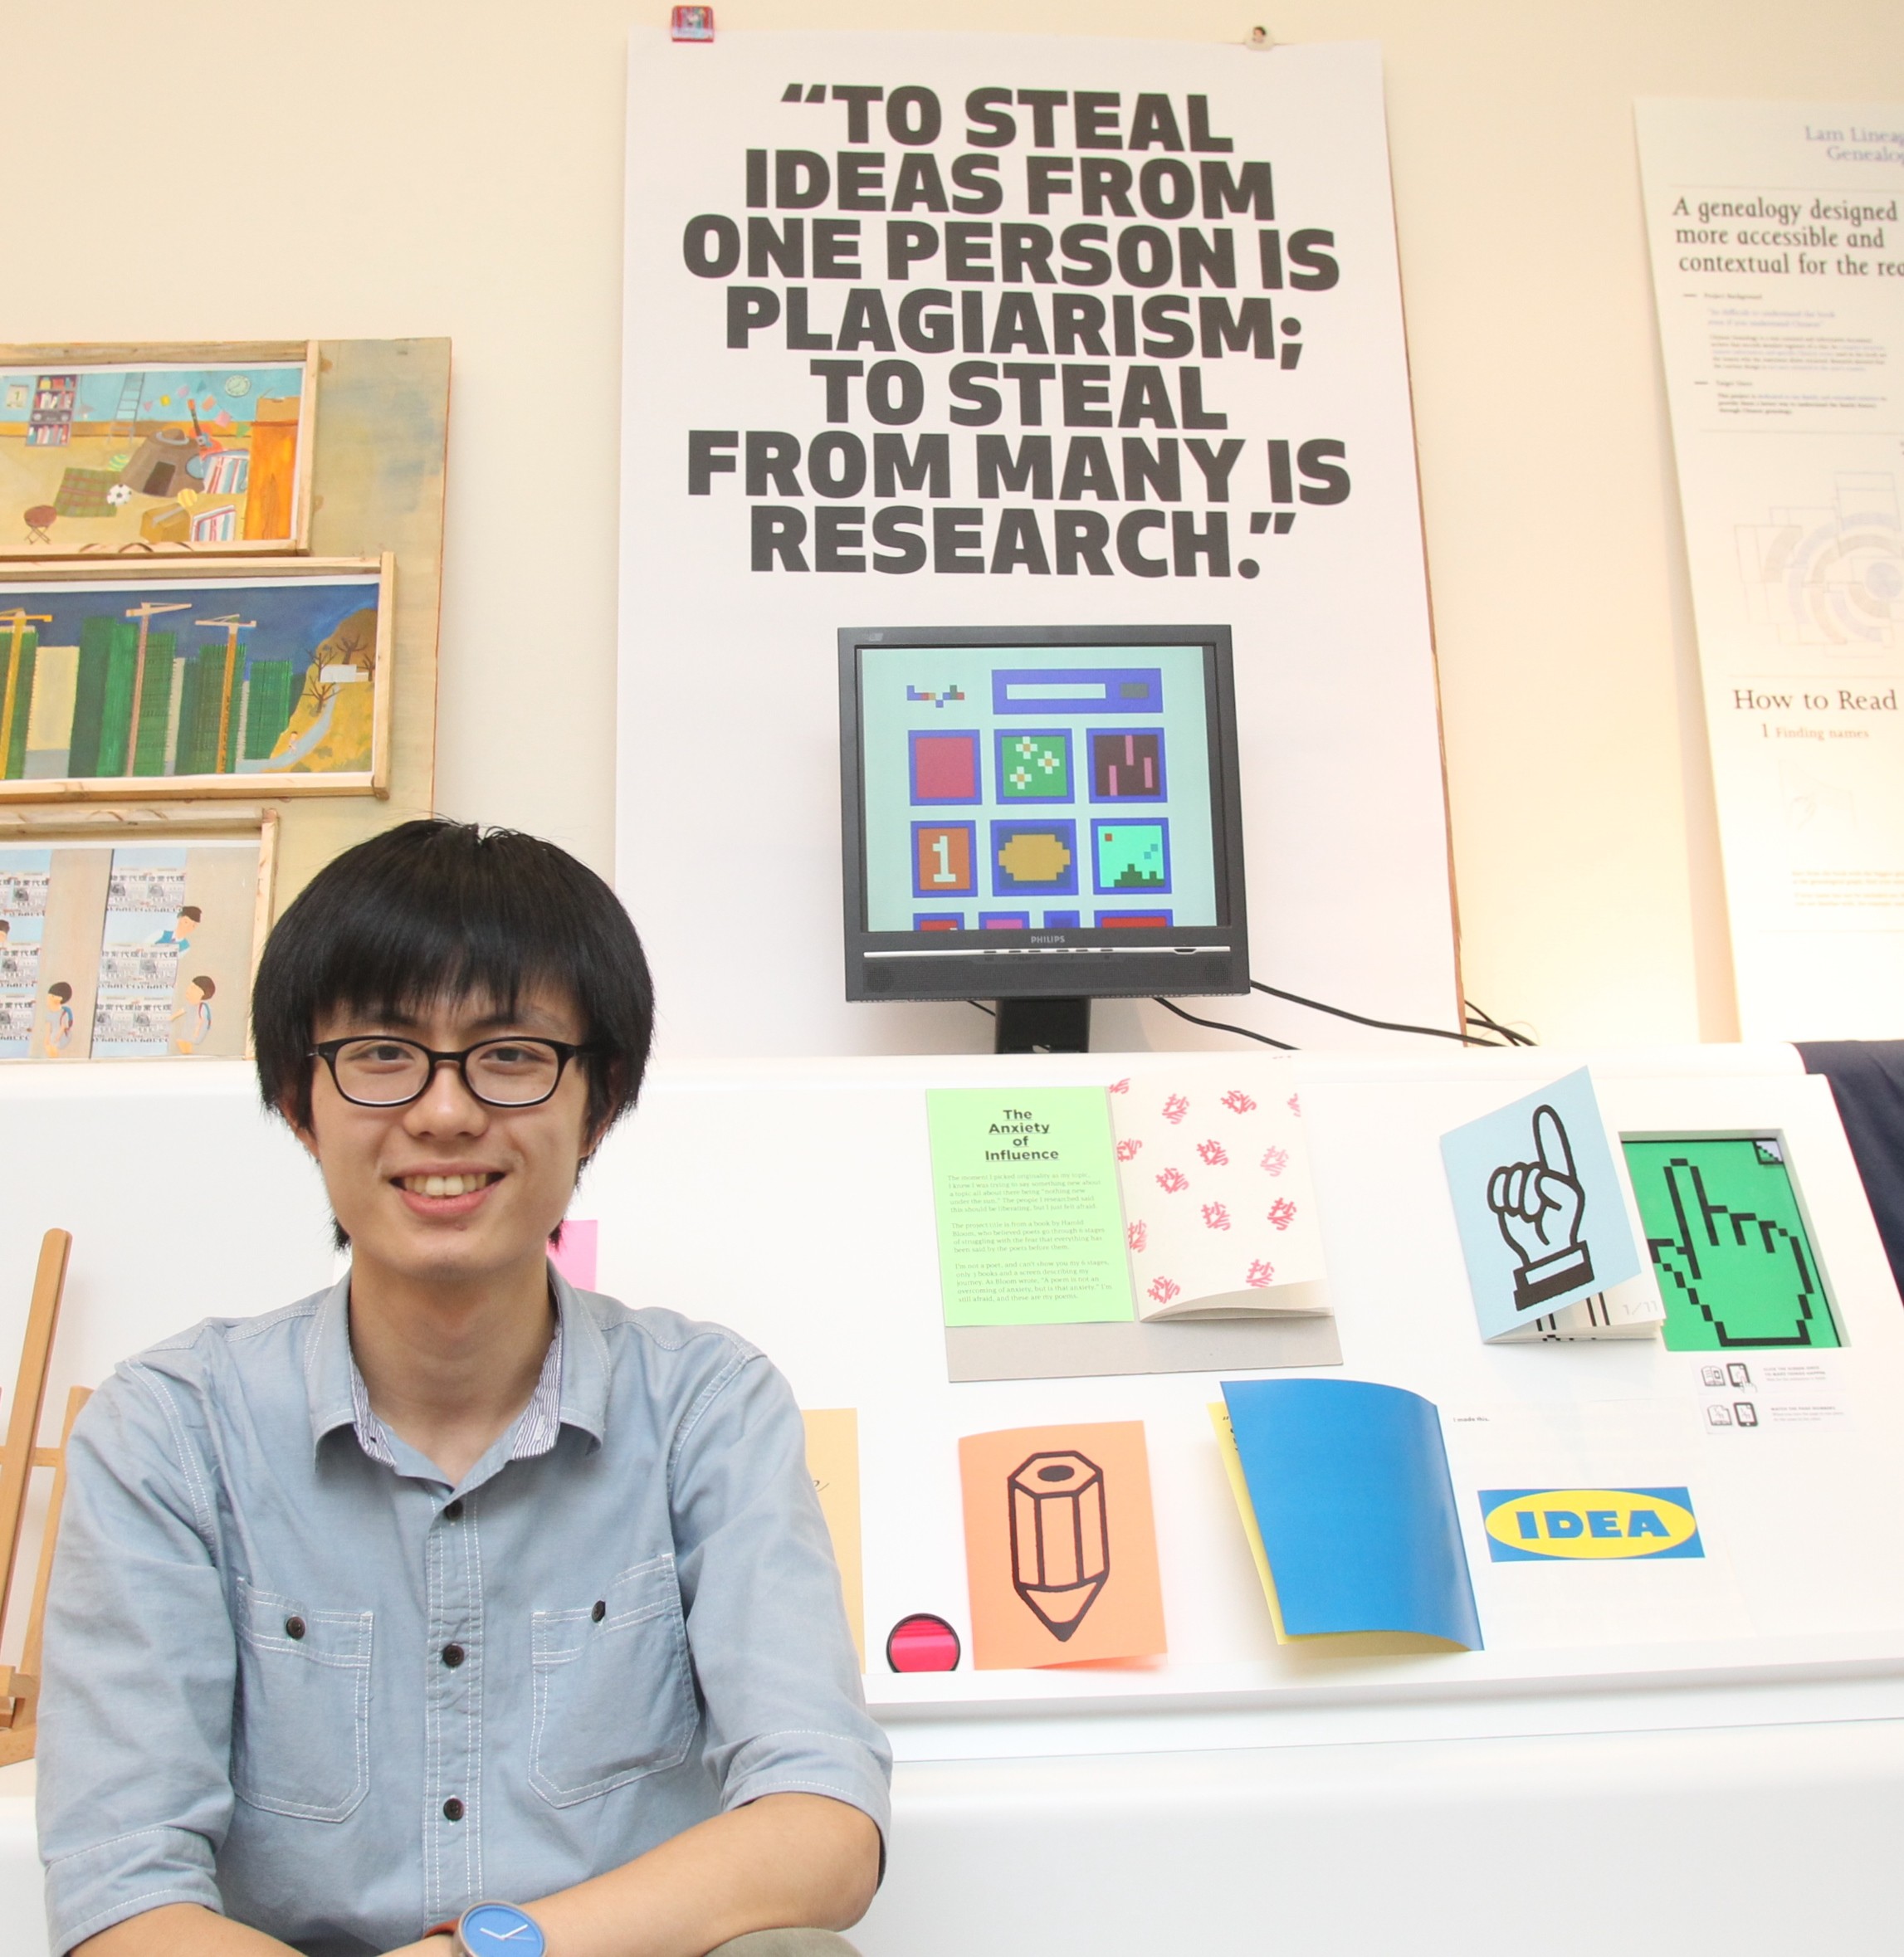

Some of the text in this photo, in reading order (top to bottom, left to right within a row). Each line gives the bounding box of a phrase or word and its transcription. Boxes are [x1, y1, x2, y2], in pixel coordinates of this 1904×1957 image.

[964, 86, 1234, 154] STEAL
[1804, 124, 1844, 141] Lam
[746, 149, 1275, 222] IDEAS FROM
[1672, 196, 1897, 227] A genealogy designed
[1676, 226, 1884, 248] more accessible and
[683, 213, 1340, 291] ONE PERSON IS
[1678, 252, 1790, 274] contextual
[1799, 252, 1827, 275] for
[1836, 254, 1868, 276] the
[726, 285, 1303, 370] PLAGIARISM;
[809, 359, 1228, 430] TO STEAL
[688, 430, 1351, 505] FROM MANY IS
[1735, 689, 1898, 710] How to Read
[1775, 727, 1824, 741] Finding
[1829, 728, 1869, 739] names
[932, 835, 956, 883] 1
[1031, 935, 1066, 944] PHILIPS
[1003, 1110, 1033, 1120] The
[989, 1123, 1050, 1135] Anxiety
[1013, 1136, 1029, 1146] of
[985, 1149, 1059, 1161] Influence
[957, 1287, 997, 1296] overcoming
[1623, 1301, 1658, 1315] 1/11
[1516, 1510, 1671, 1540] IDEA
